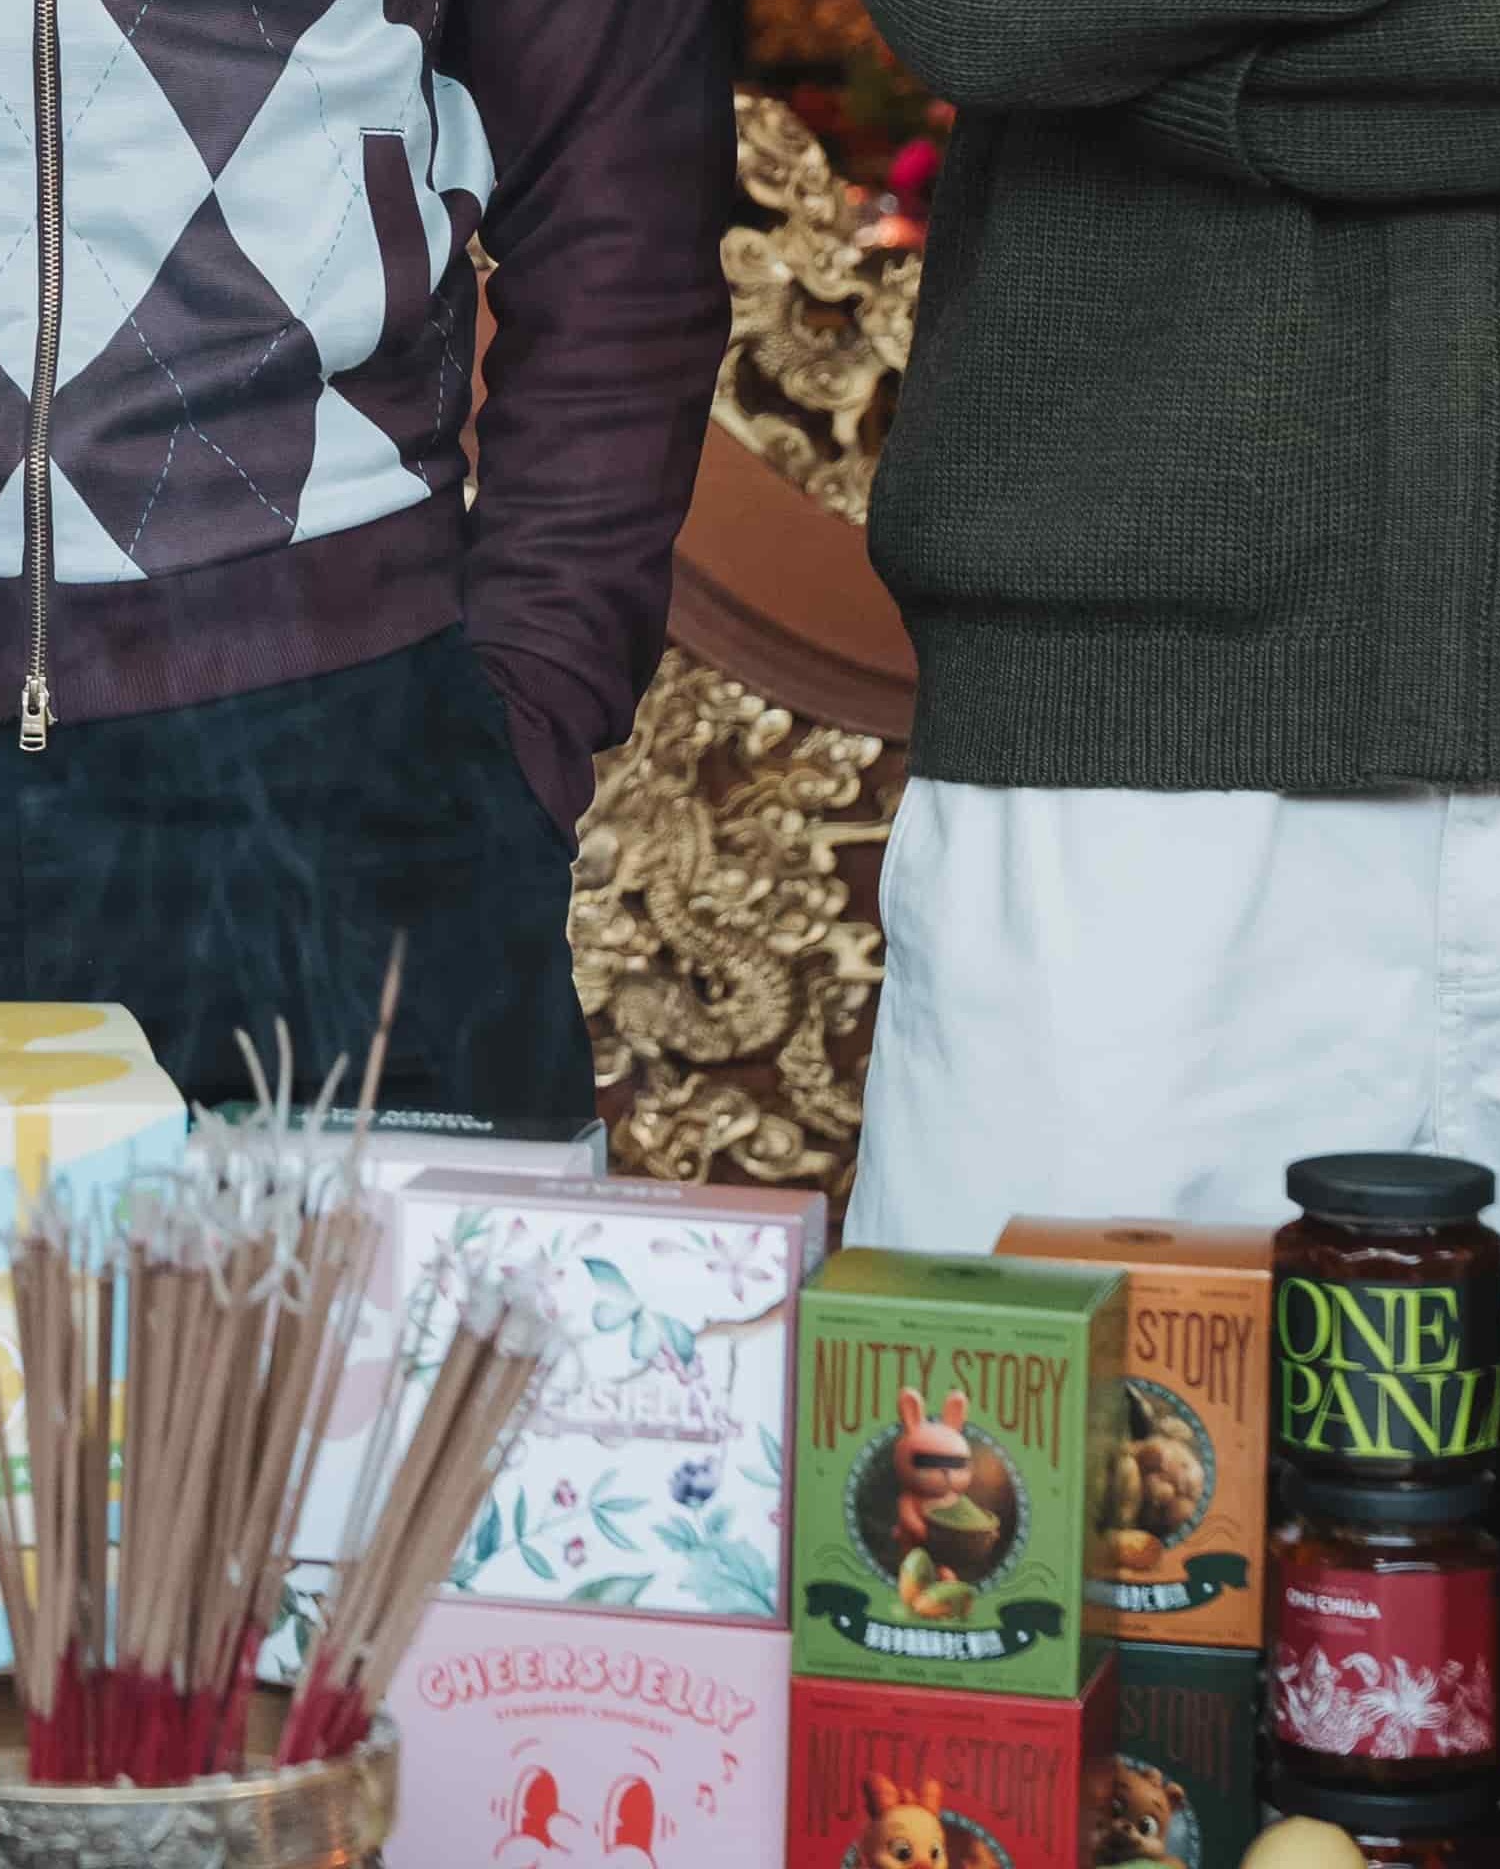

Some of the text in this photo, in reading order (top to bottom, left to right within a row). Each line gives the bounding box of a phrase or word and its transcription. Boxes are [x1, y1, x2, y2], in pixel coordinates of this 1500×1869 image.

[1134, 1308, 1254, 1423] STORY
[1276, 1276, 1460, 1374] ONE
[811, 1335, 1070, 1468] NUTTY STORY
[417, 1643, 758, 1735] CHEERSJELLY
